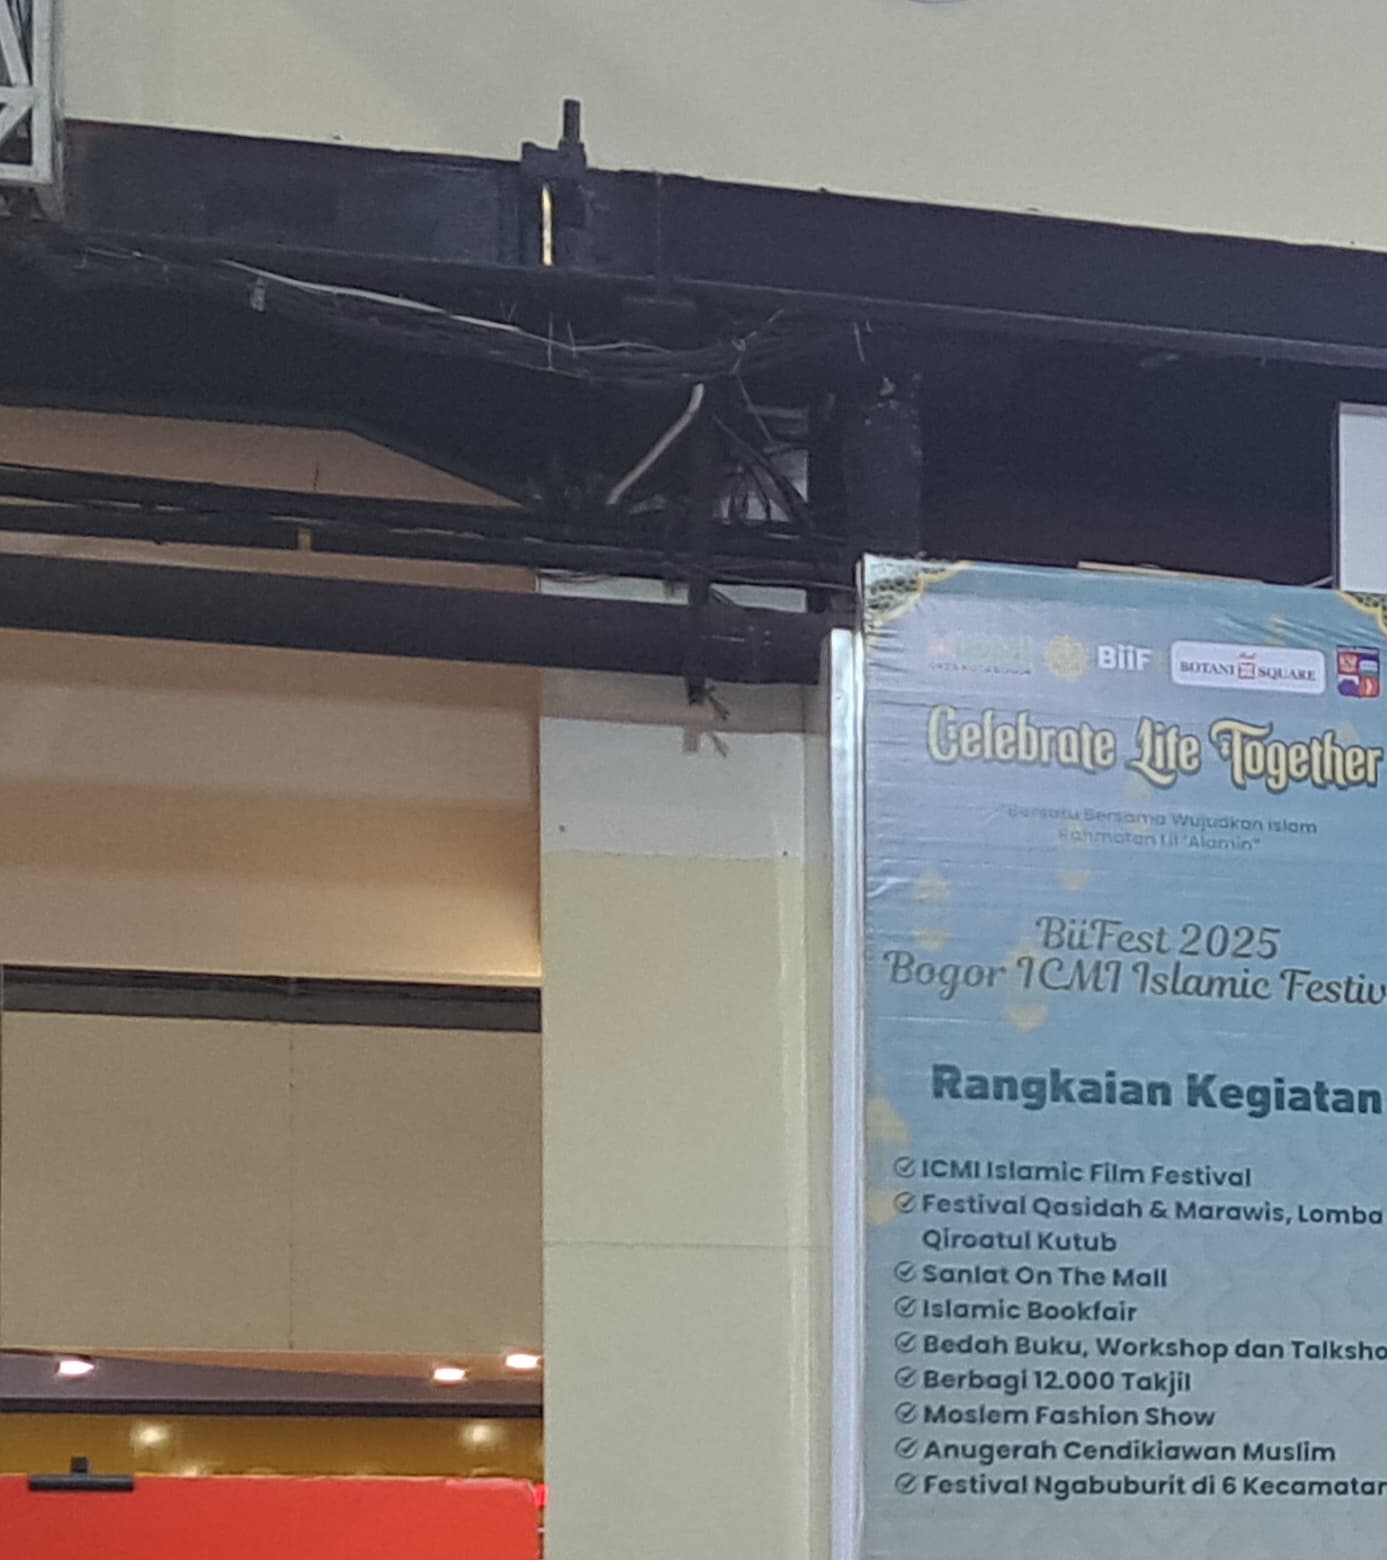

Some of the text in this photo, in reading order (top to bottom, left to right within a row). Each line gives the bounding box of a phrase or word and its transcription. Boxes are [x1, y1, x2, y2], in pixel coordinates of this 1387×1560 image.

[1180, 660, 1316, 681] BOTANI SQUARE
[927, 703, 1383, 794] Celebrate Life Together
[1180, 923, 1281, 960] 2025
[883, 950, 1006, 1000] Bogor
[1017, 957, 1123, 995] ICMI
[1132, 961, 1272, 1000] Islamic
[931, 1063, 1384, 1118] Rangkaian Kegiatan
[921, 1158, 1252, 1187] ICMI Islamic Film Festival
[922, 1194, 1384, 1225] Festival Qasidah & Marawis, Lomba
[1038, 1230, 1118, 1252] Kutub
[922, 1263, 1168, 1289] Sanlat On The Mall
[922, 1299, 1138, 1322] Islamic Bookfair
[922, 1334, 1009, 1356] Bedah
[1015, 1335, 1089, 1358] Buku,
[1095, 1337, 1229, 1363] Workshop
[1234, 1339, 1285, 1360] dan
[923, 1369, 1191, 1397] Berbagi 12.000 Takjil
[923, 1404, 1216, 1428] Moslem Fashion Show
[923, 1440, 1337, 1466] Anugerah Cendikiawan Muslim
[923, 1474, 1028, 1496] Festival
[1034, 1475, 1186, 1501] Ngabuburit
[1191, 1475, 1217, 1497] di
[1222, 1476, 1237, 1497] 6
